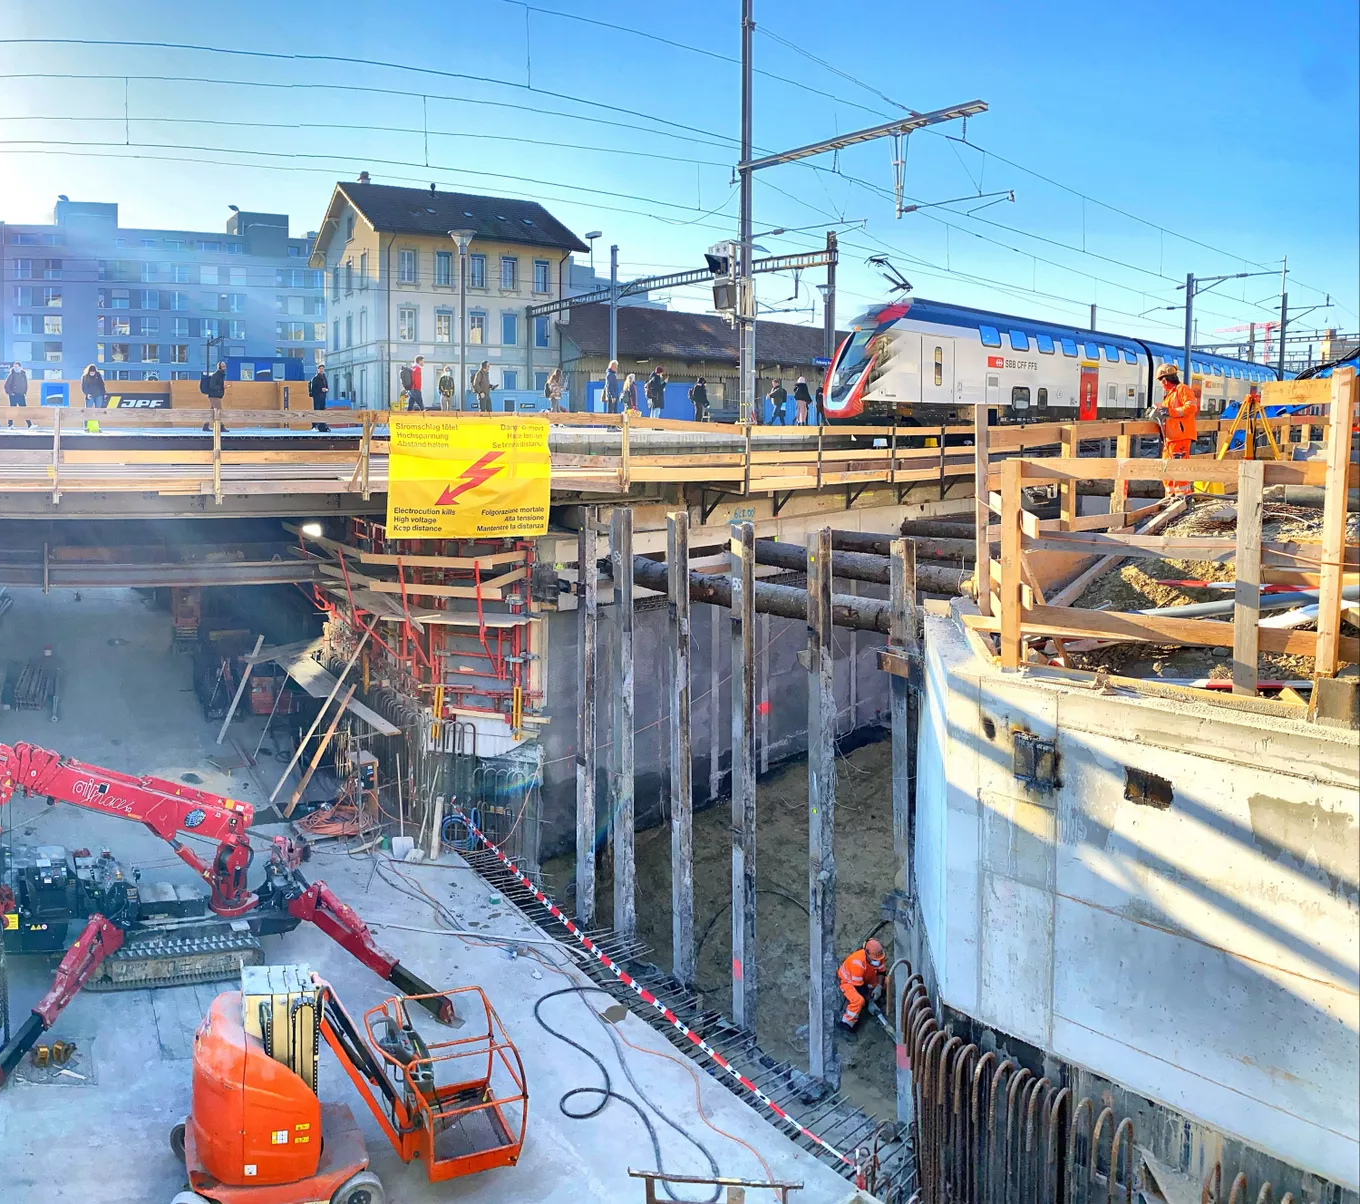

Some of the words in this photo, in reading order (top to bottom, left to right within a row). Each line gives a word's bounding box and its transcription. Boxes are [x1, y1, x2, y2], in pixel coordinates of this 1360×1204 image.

[1005, 360, 1016, 369] SBB
[1017, 361, 1027, 369] CFF
[1028, 362, 1038, 370] FFS
[120, 399, 164, 408] JPF
[396, 423, 440, 431] Stromschlag
[397, 432, 449, 441] Hochspannung
[393, 507, 440, 515] Electrocution
[481, 508, 519, 516] Folgorazione
